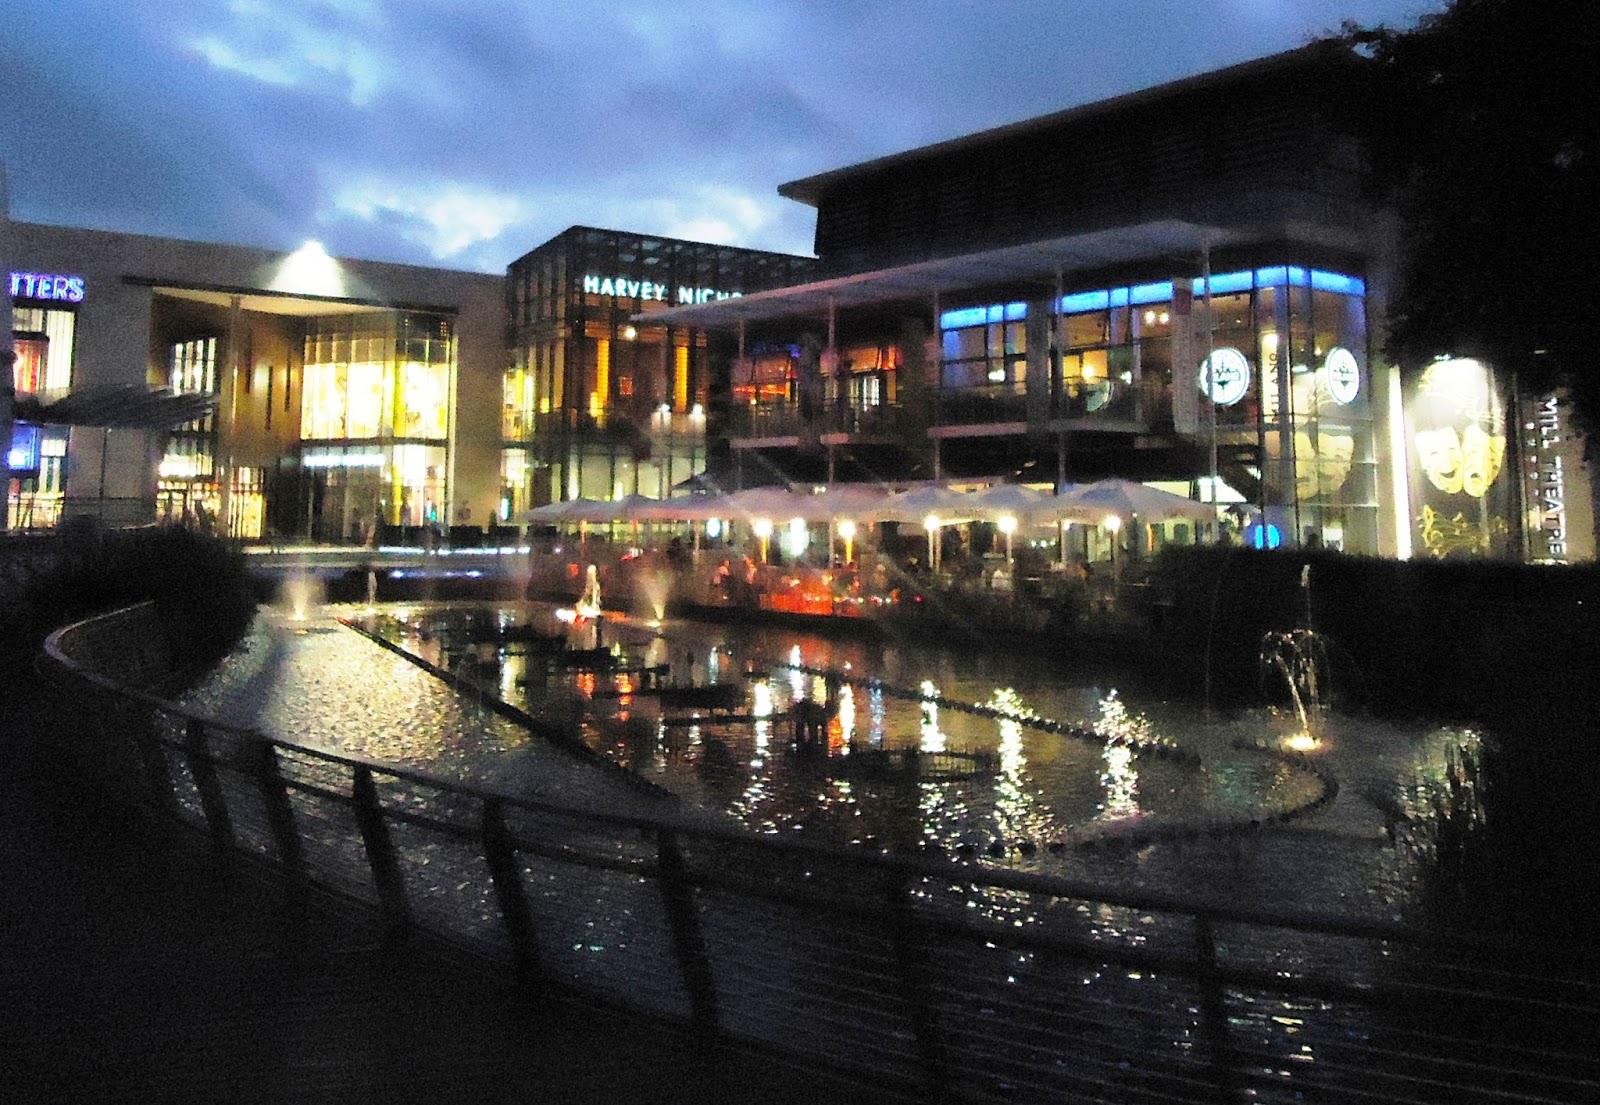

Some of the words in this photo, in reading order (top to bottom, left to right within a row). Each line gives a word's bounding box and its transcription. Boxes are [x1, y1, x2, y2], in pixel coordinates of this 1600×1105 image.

[584, 275, 665, 301] HARVEY
[1538, 397, 1559, 449] MILL
[1541, 455, 1567, 555] THEATRE
